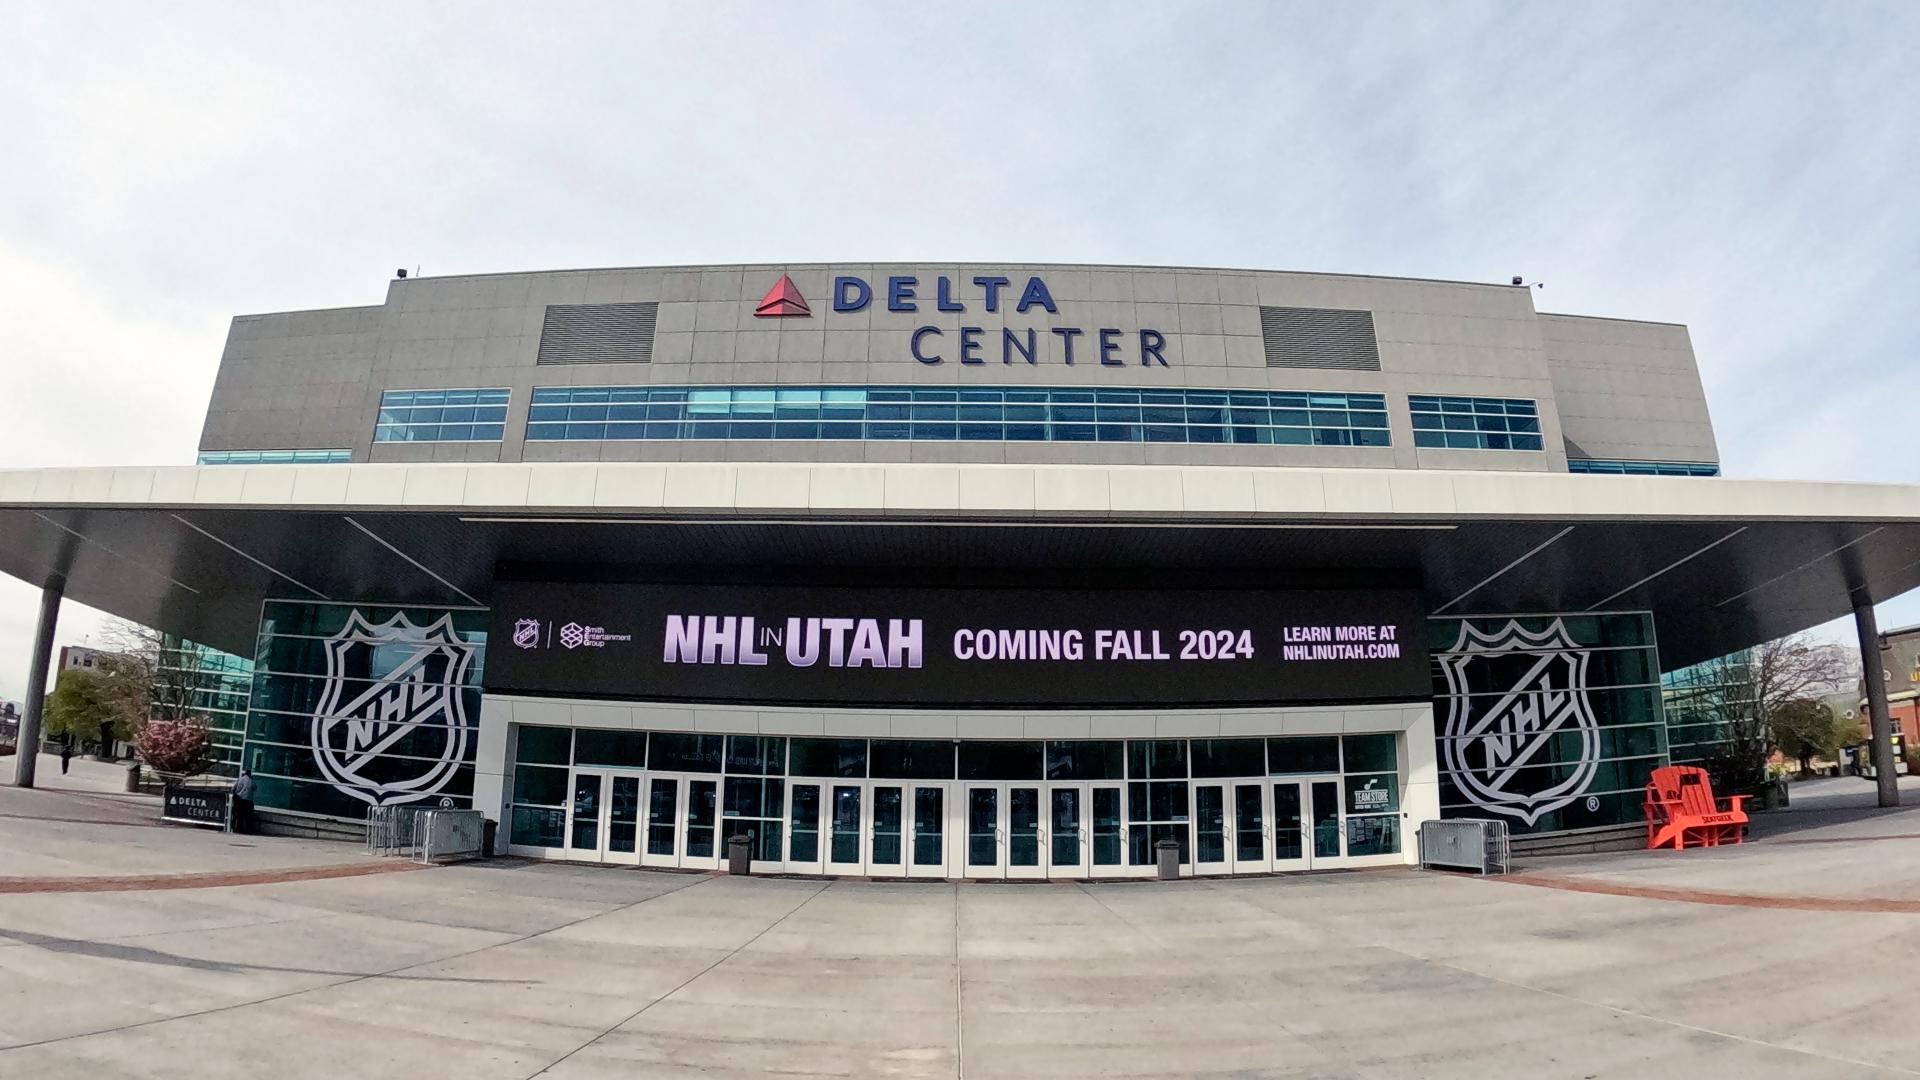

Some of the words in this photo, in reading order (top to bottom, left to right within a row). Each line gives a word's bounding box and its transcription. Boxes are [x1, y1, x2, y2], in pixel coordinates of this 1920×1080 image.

[832, 276, 1058, 312] DELTA
[910, 326, 1168, 367] CENTER
[519, 626, 536, 642] NHL
[584, 633, 631, 641] Entertainment
[664, 614, 768, 665] NHL
[760, 626, 782, 647] IN
[785, 617, 923, 669] UTAH
[1283, 626, 1332, 642] LEARN
[1335, 626, 1377, 641] MORE
[1379, 625, 1397, 640] AT
[583, 639, 605, 647] Group
[953, 628, 1084, 661] COMING
[1094, 629, 1170, 661] FALL
[1178, 629, 1255, 660] 2024
[1283, 643, 1400, 661] NHLINUTAH.COM
[345, 663, 437, 761] NHL
[1481, 671, 1566, 780] NHL
[178, 797, 207, 807] DELTA
[1354, 791, 1371, 804] TEAM
[1371, 790, 1388, 803] STORE
[187, 807, 219, 817] CENTER
